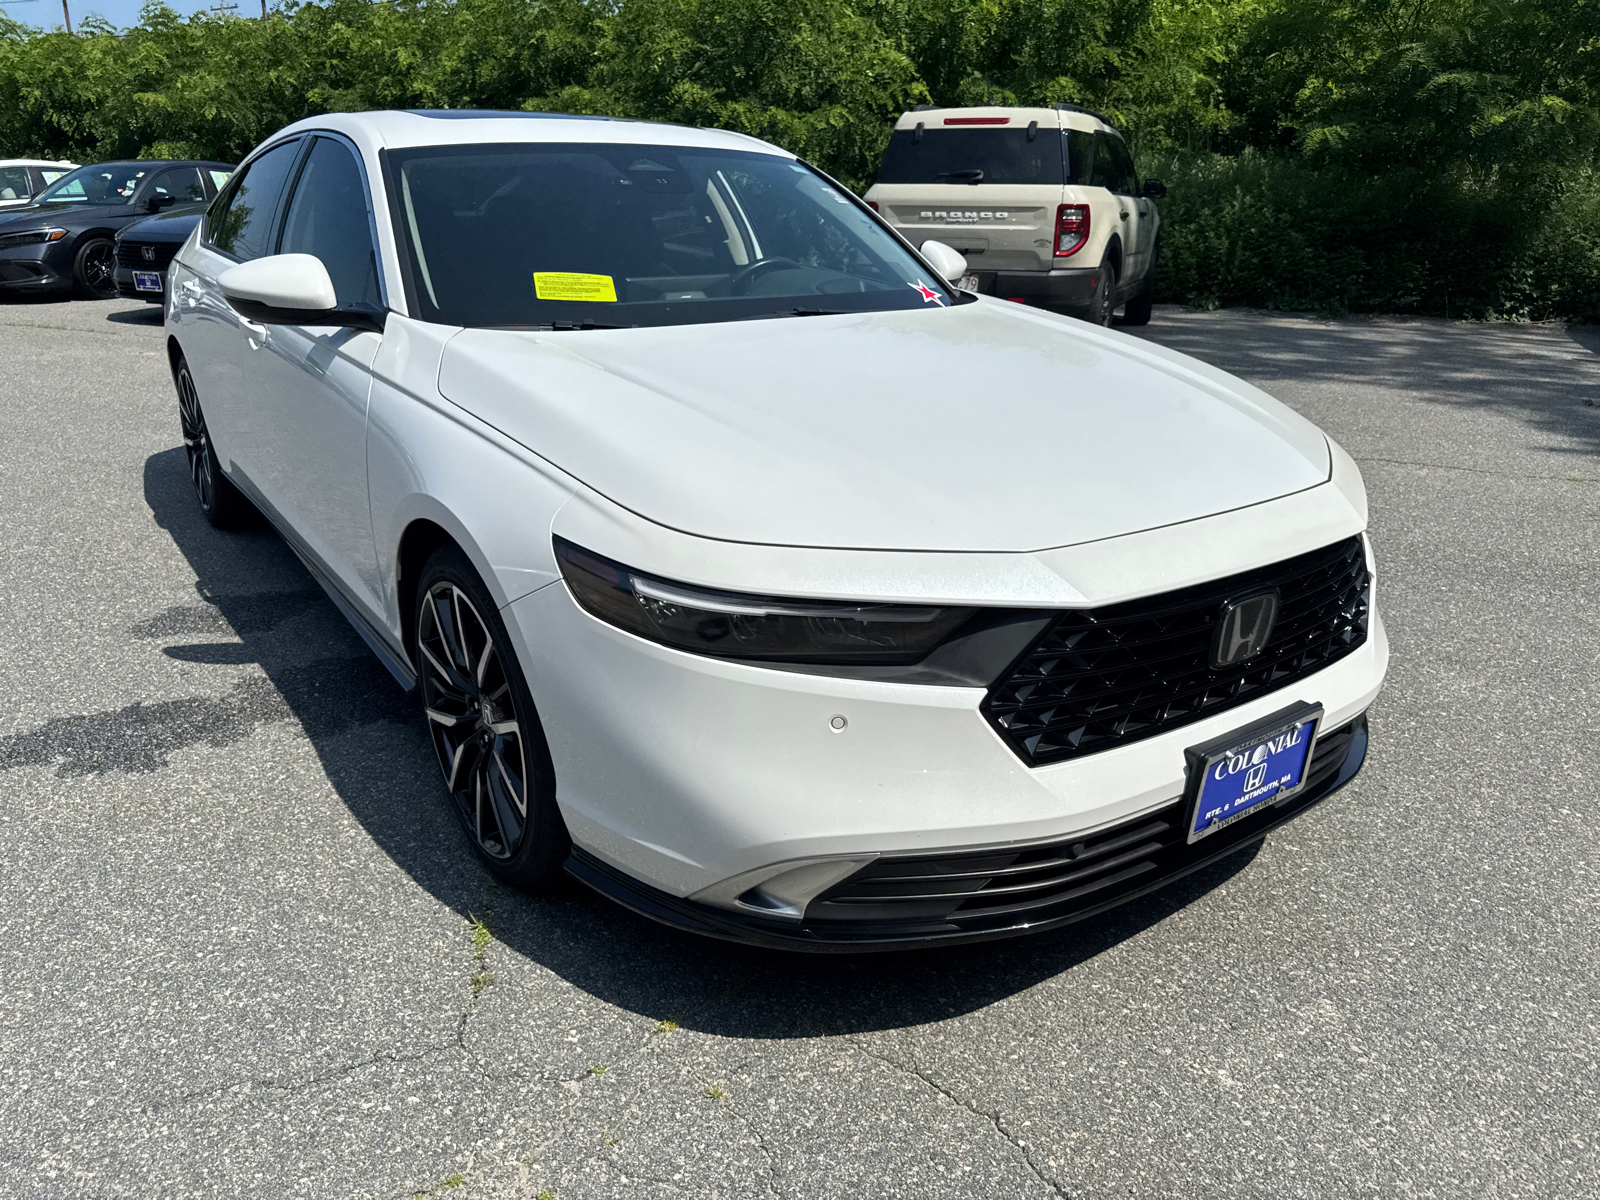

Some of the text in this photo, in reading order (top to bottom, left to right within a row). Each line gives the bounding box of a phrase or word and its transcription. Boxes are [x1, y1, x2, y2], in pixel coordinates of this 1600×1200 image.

[1214, 730, 1302, 780] COLONIAL
[1205, 807, 1222, 820] RTE.
[1224, 803, 1230, 812] 6
[1234, 780, 1279, 806] DARTMOUTH,
[1280, 774, 1291, 784] MA
[1217, 796, 1277, 829] COLONIAL HONDA
